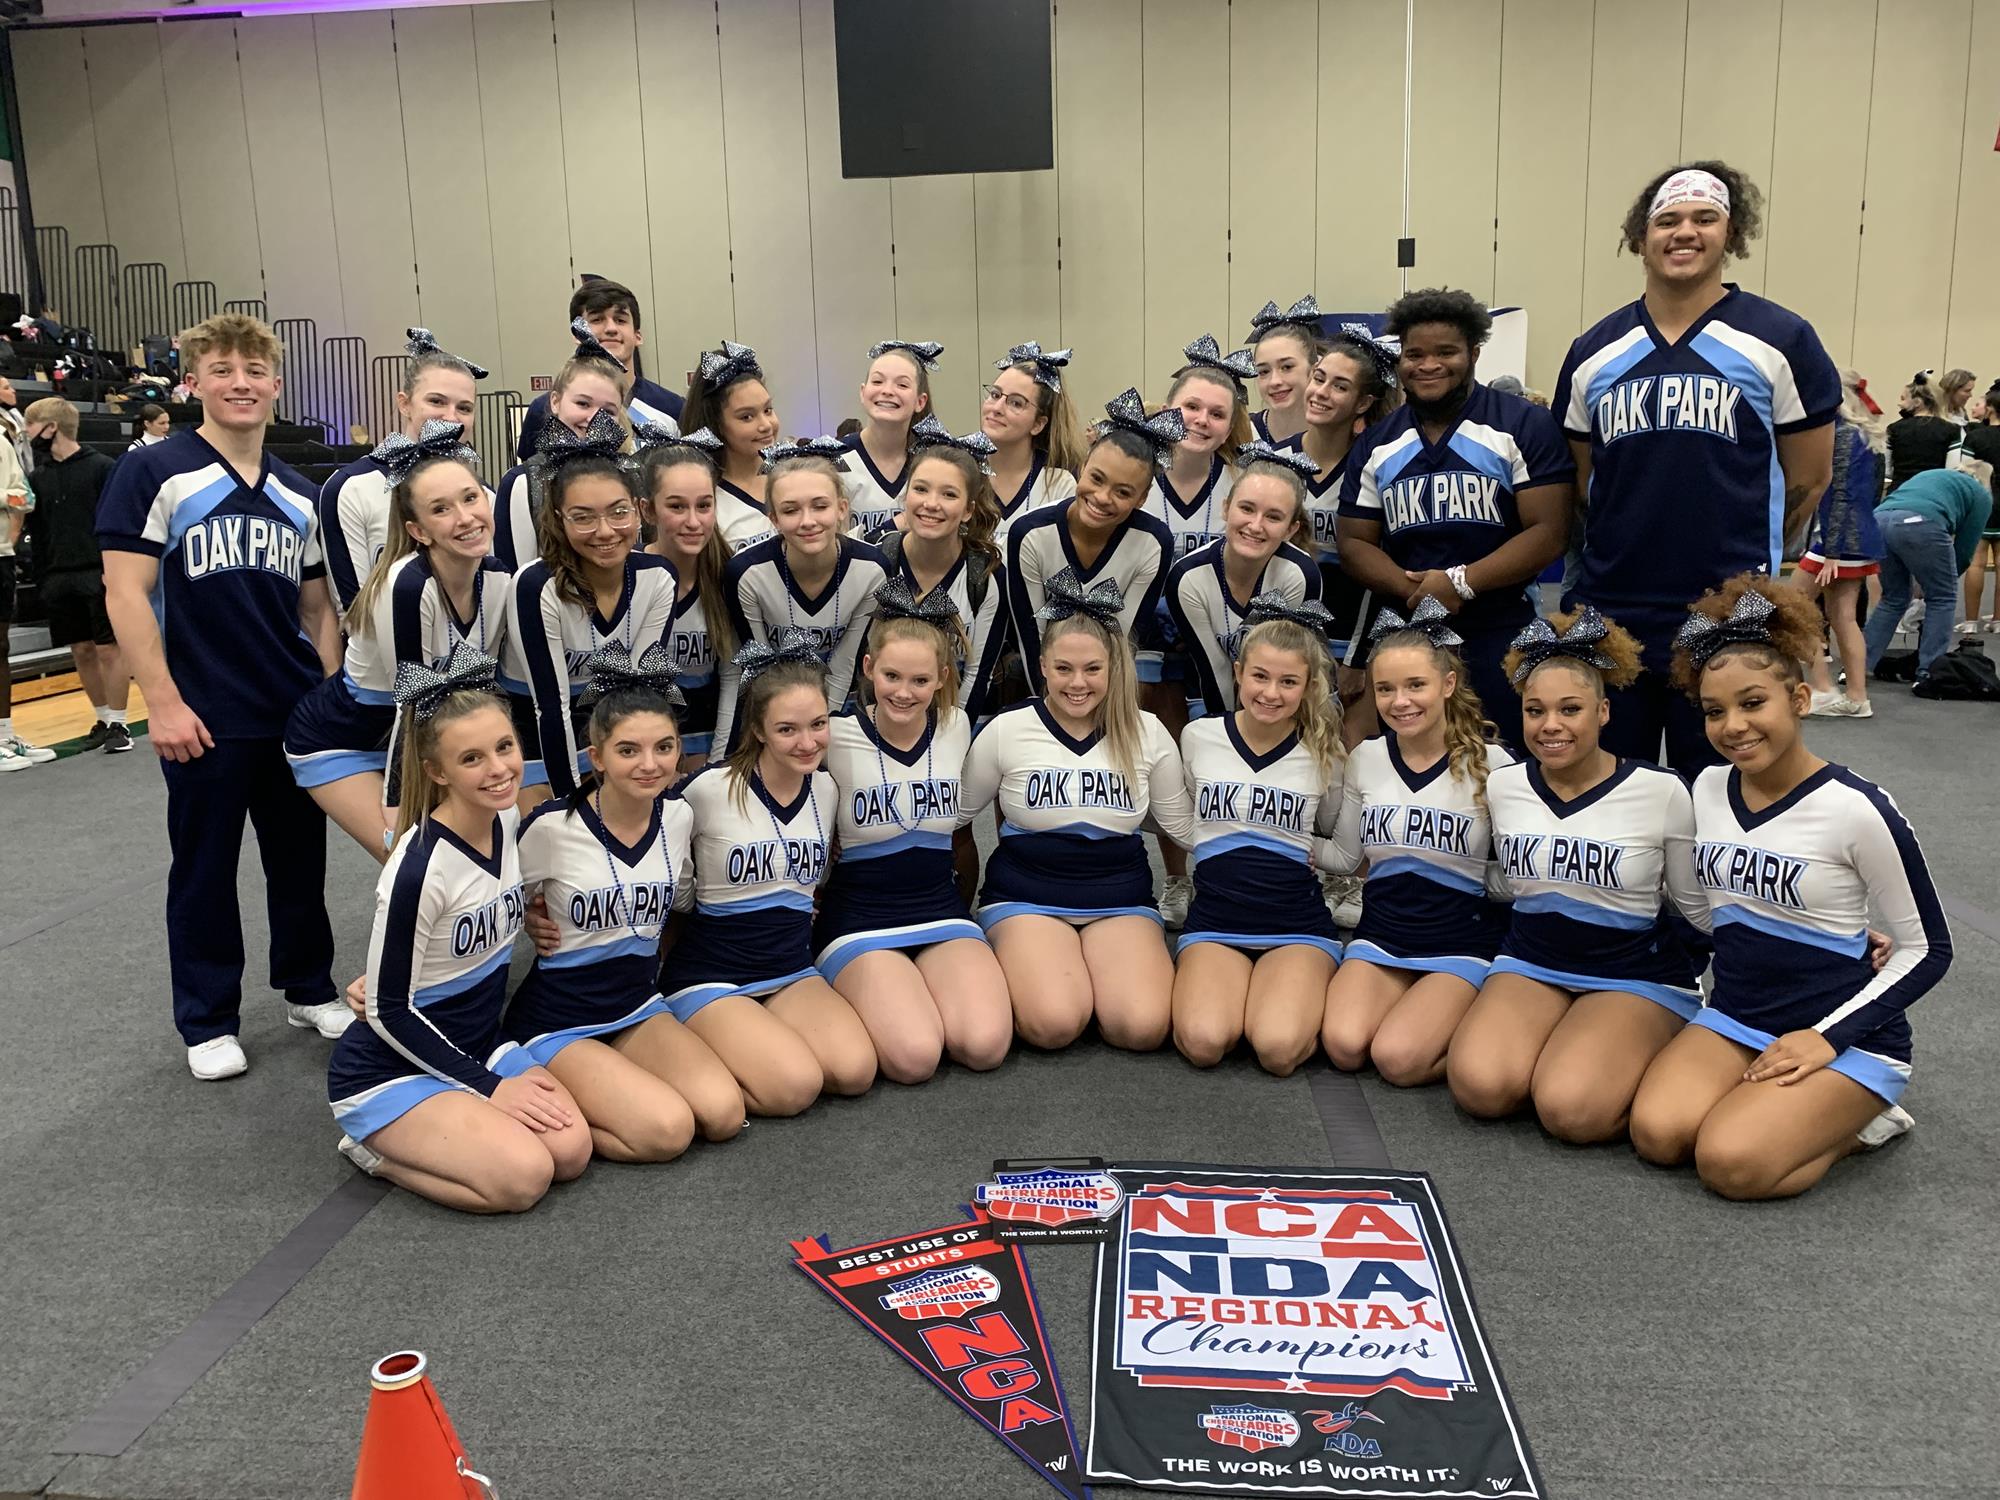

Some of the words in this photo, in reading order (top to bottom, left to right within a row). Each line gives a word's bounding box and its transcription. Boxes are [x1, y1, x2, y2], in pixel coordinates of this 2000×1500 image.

[1598, 378, 1652, 448] OAK
[1657, 374, 1743, 445] PARK
[1382, 476, 1433, 534] OAK
[1431, 471, 1506, 527] PARK
[184, 515, 244, 582] OAK
[246, 515, 305, 589] PARK
[851, 782, 904, 828] OAK
[908, 779, 960, 820] PARK
[1025, 769, 1074, 809] OAK
[1077, 769, 1136, 812] PARK
[1200, 782, 1245, 822] OAK
[1247, 784, 1308, 833] PARK
[1360, 805, 1400, 846] OAK
[1402, 805, 1473, 857] PARK
[726, 840, 777, 885] OAK
[1501, 834, 1545, 880] OAK
[1549, 835, 1625, 891] PARK
[1693, 842, 1733, 891] AK
[1727, 844, 1809, 911] PARK
[451, 897, 499, 959] OAK
[570, 885, 623, 931] OAK
[627, 882, 678, 927] PAR
[988, 1187, 1116, 1201] CHEERLEADERS
[1002, 1196, 1098, 1209] ASSOCIATION
[1010, 1178, 1095, 1190] NATIONAL
[1130, 1198, 1420, 1242] NCA
[838, 1248, 895, 1270] BEST
[902, 1237, 947, 1254] USE
[953, 1230, 980, 1242] OF
[875, 1249, 963, 1275] STUNTS
[890, 1277, 995, 1304] CHEERLEADERS
[905, 1272, 973, 1295] NATIONAL
[1128, 1252, 1438, 1301] NDA
[905, 1291, 986, 1306] ASSOCIATION
[1127, 1294, 1446, 1332] REGIONAL
[1141, 1314, 1437, 1370] Champions
[918, 1311, 1063, 1433] NCA
[1206, 1418, 1296, 1435] CHEERLEADERS
[1216, 1425, 1284, 1442] ASSOCIATION
[1221, 1414, 1281, 1423] NATIONAL
[1324, 1432, 1382, 1455] NDA
[1162, 1458, 1210, 1472] THE
[1218, 1461, 1293, 1477] WORK
[1300, 1459, 1322, 1474] IS
[1328, 1462, 1420, 1482] WORTH
